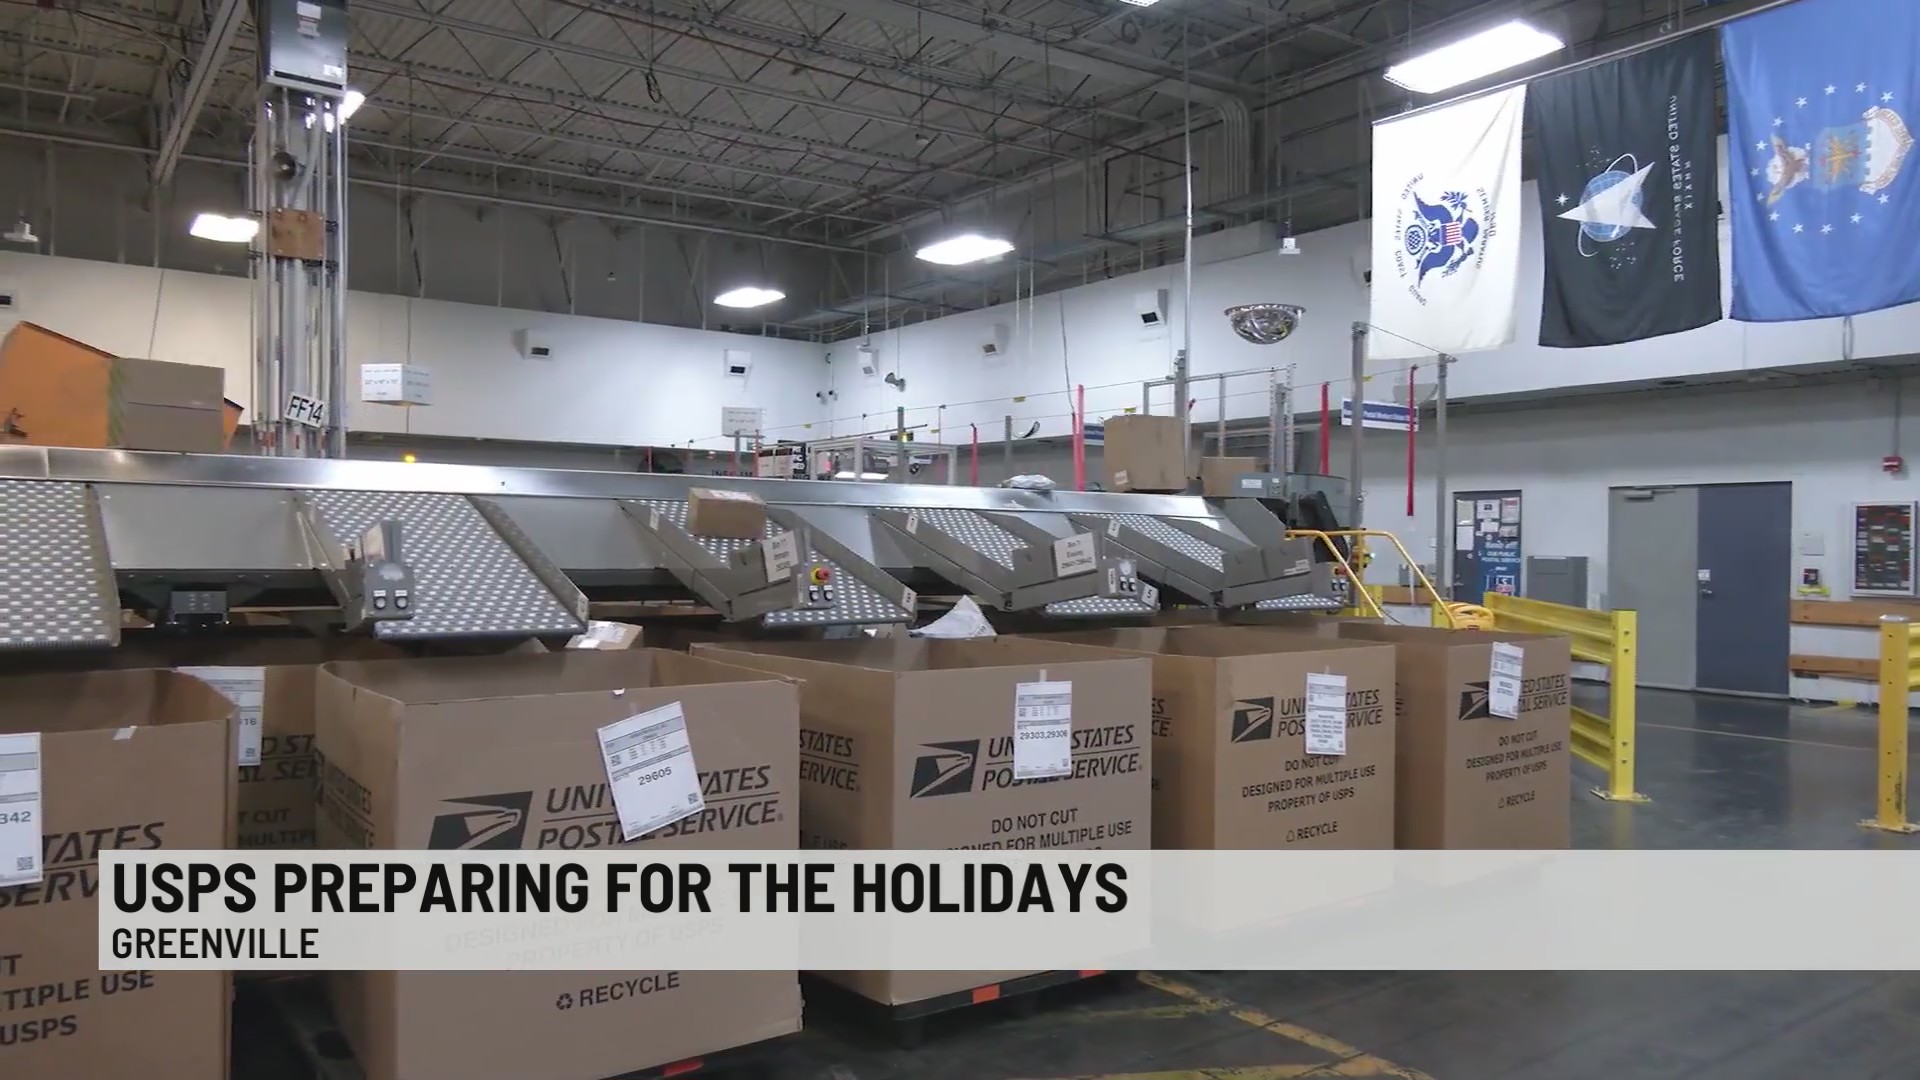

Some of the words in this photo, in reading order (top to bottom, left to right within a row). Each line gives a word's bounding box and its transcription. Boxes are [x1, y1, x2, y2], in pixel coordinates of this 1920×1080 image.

[287, 395, 323, 424] FF14
[1345, 689, 1380, 708] TATES
[1345, 708, 1383, 729] RVICE
[1019, 729, 1068, 741] 29303,29306
[1071, 724, 1134, 750] STATES
[1285, 759, 1299, 772] DO
[1301, 755, 1321, 769] NOT
[1466, 753, 1504, 769] DESIGNED
[1505, 750, 1520, 761] FOR
[637, 766, 673, 786] 29605
[800, 760, 858, 791] ERVICE
[1242, 779, 1293, 798] DESIGNED
[1295, 776, 1313, 789] FOR
[1315, 768, 1358, 785] MULTIPLE
[1360, 764, 1376, 778] USE
[1486, 766, 1520, 782] PROPERTY
[547, 783, 606, 814] UNI
[697, 765, 771, 796] TATES
[1268, 793, 1317, 813] PROPERTY
[1319, 791, 1331, 803] OF
[1332, 787, 1355, 801] USPS
[1506, 790, 1535, 806] RECYCLE
[0, 811, 32, 825] 342
[992, 817, 1013, 834] DO
[1017, 812, 1047, 830] NOT
[1050, 807, 1078, 826] CUT
[1297, 821, 1338, 840] RECYCLE
[43, 822, 165, 865] TATES
[1040, 824, 1105, 849] MULTIPLE
[1108, 820, 1132, 838] USE
[0, 979, 90, 1012] TIPLE
[101, 970, 155, 996] USE
[580, 971, 680, 1007] RECYCLE
[0, 1015, 78, 1046] USPS
